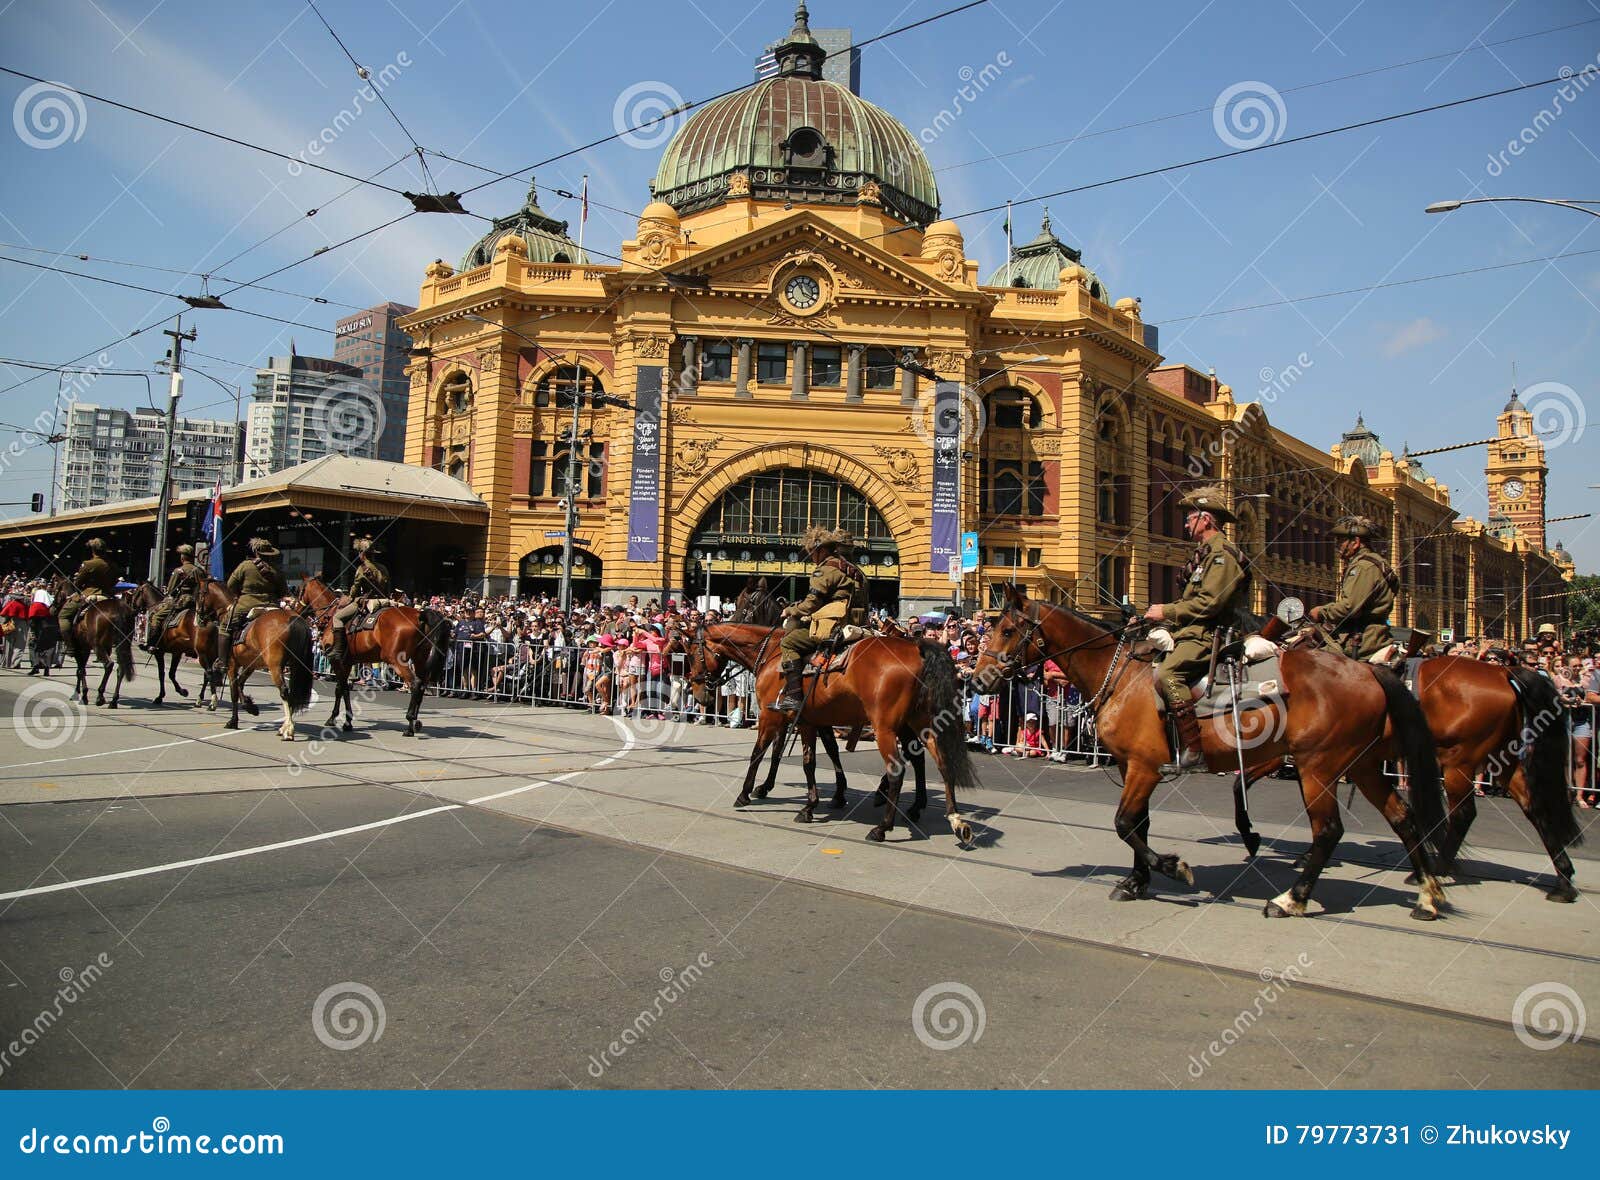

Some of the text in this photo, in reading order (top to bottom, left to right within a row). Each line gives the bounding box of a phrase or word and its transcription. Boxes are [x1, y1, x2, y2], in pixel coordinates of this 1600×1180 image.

[359, 316, 373, 328] SUN
[638, 436, 655, 444] Your
[636, 444, 657, 452] Night
[721, 535, 803, 546] FLINDERS STRE
